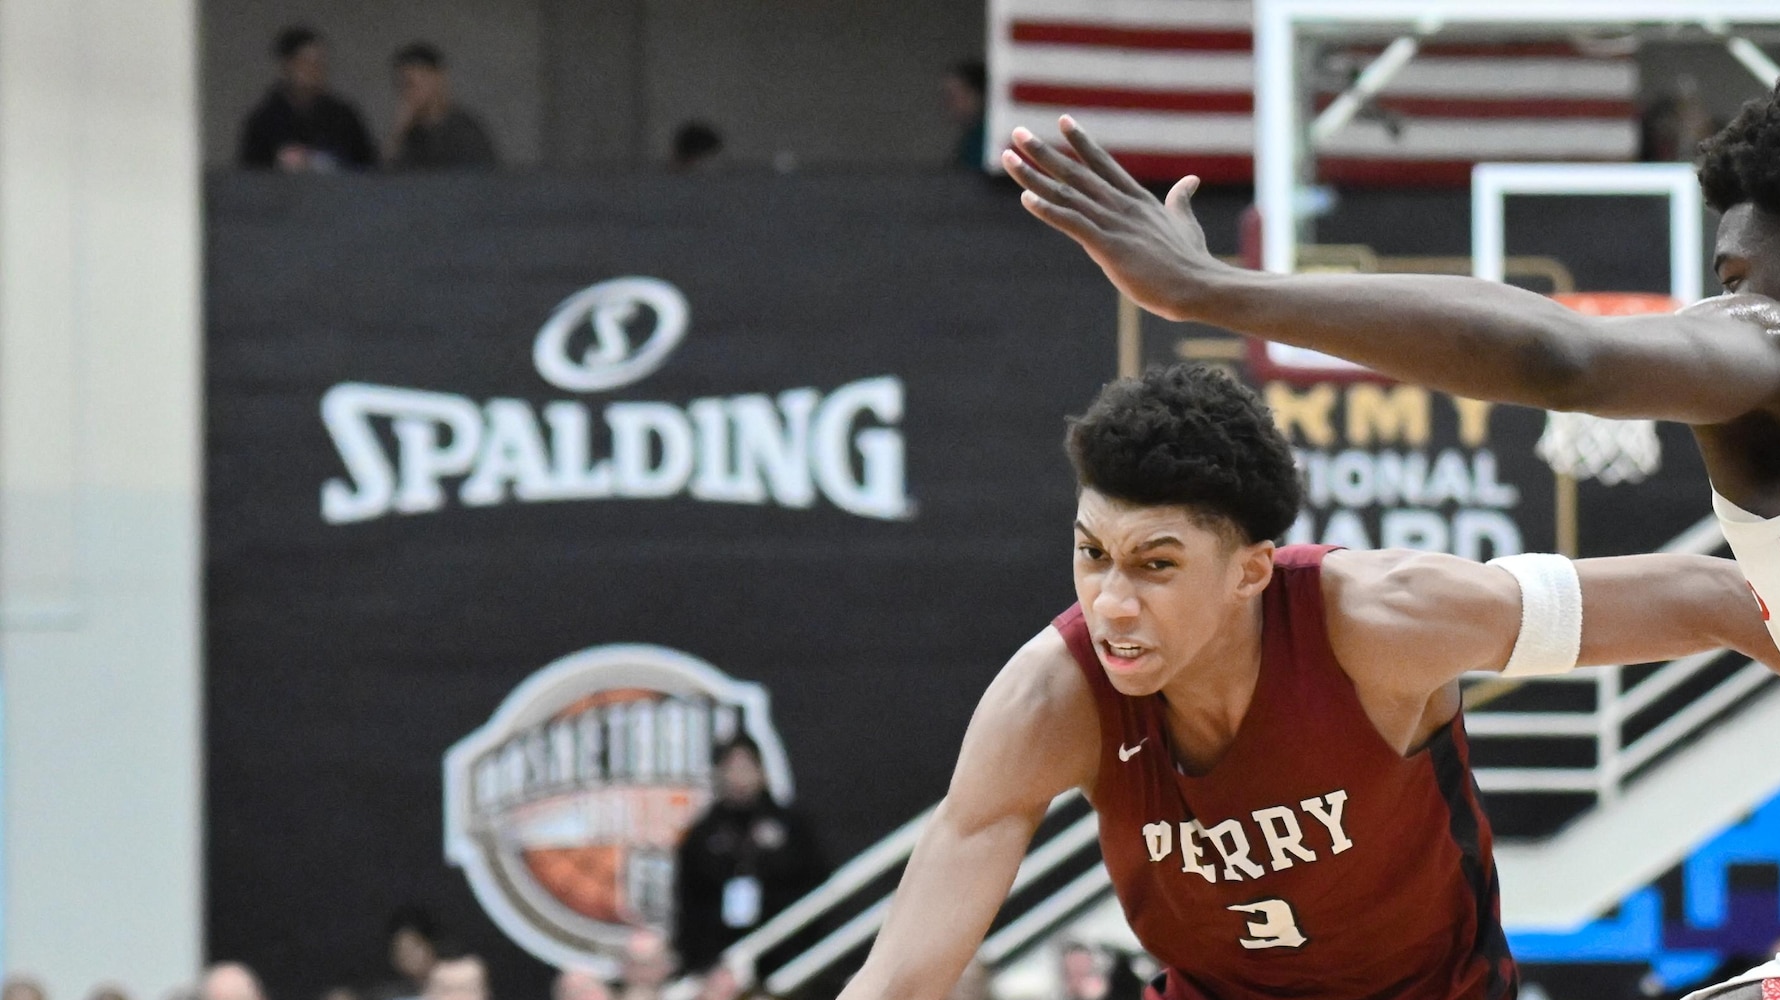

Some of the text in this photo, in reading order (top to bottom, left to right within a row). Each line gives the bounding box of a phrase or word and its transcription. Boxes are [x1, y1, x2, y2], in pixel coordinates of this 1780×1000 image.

[1262, 380, 1493, 448] RMY
[319, 376, 907, 526] SPALDING
[1226, 899, 1307, 949] 3
